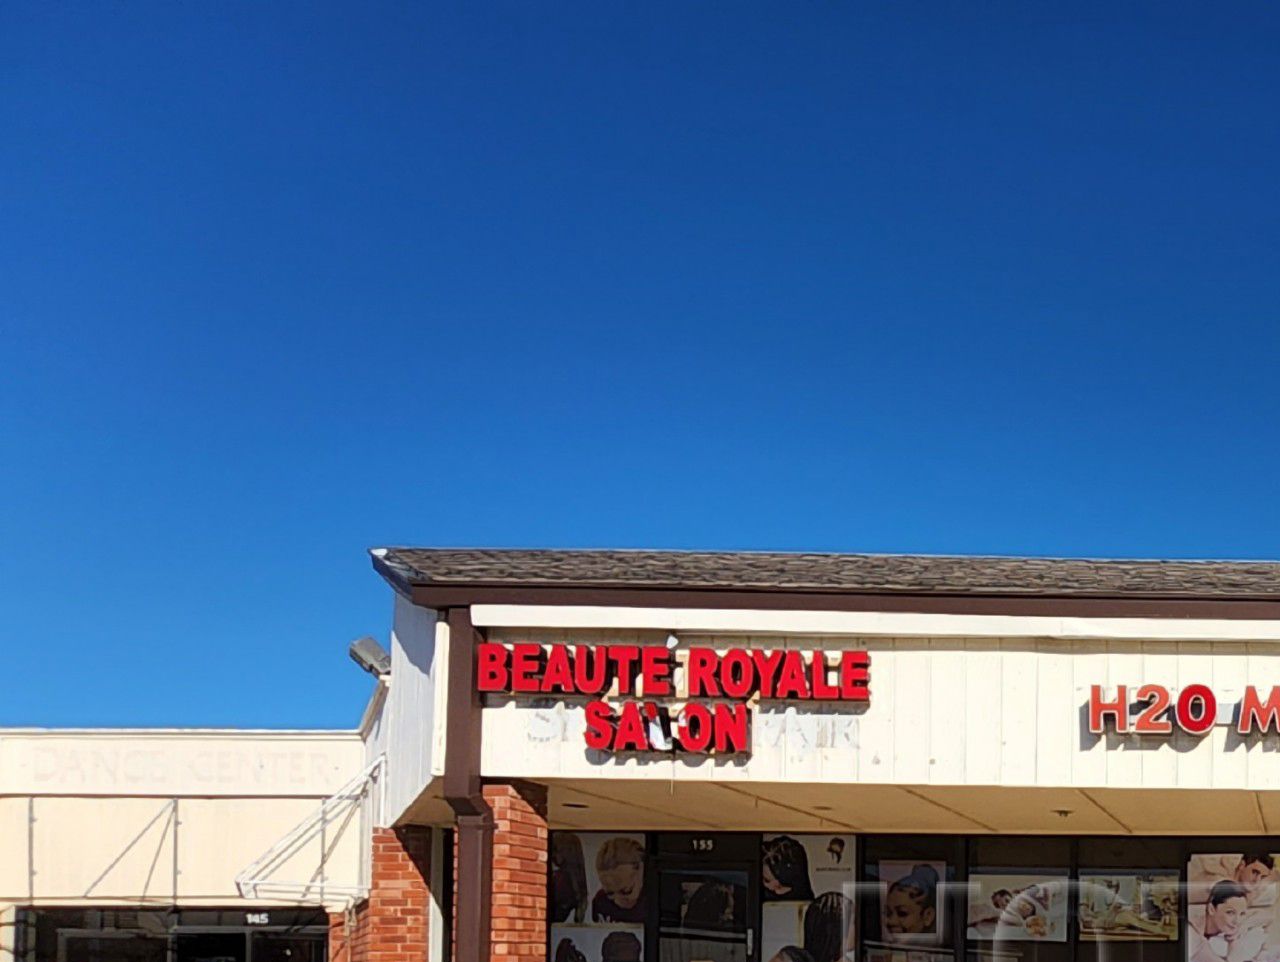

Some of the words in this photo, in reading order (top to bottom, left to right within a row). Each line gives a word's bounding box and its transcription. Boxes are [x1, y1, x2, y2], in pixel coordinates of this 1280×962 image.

[477, 642, 670, 698] BEAUTE
[688, 646, 870, 700] ROYALE
[692, 838, 714, 847] 155
[245, 912, 269, 924] 145
